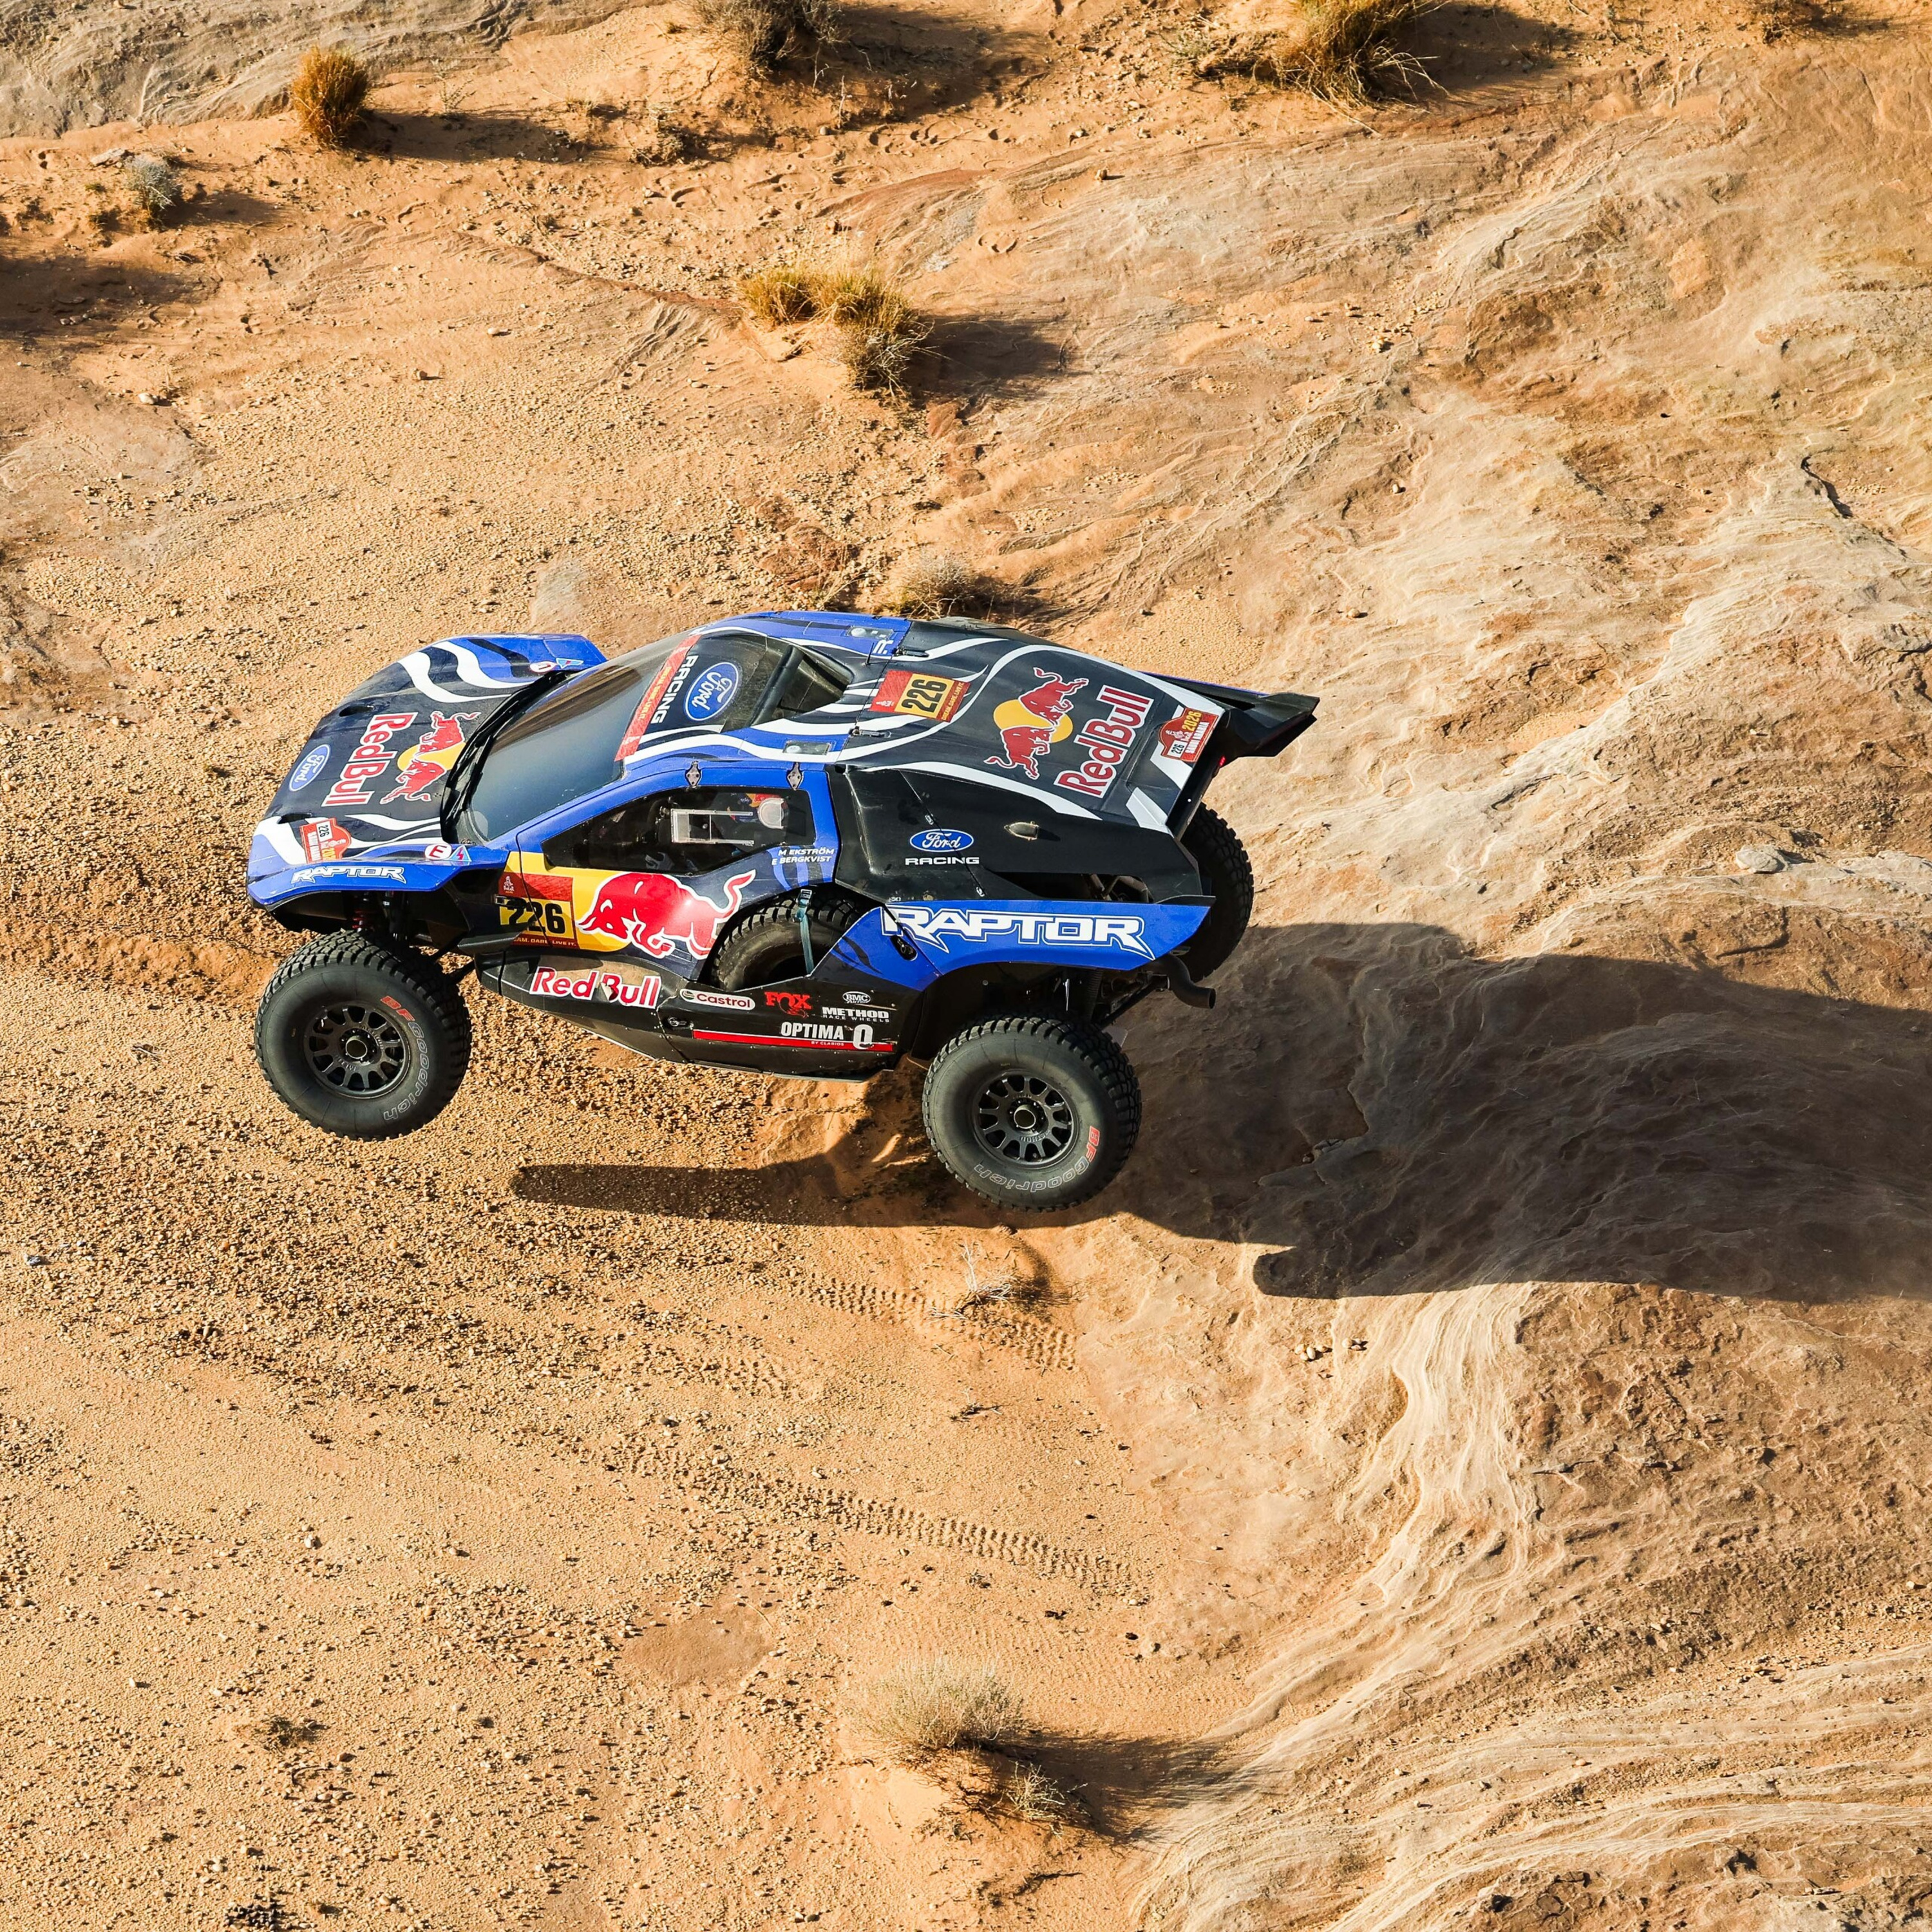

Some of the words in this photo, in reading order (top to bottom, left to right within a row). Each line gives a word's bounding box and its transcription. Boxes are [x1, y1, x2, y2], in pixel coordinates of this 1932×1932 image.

[650, 655, 699, 724] RACING
[689, 668, 734, 714] Ford
[901, 678, 947, 712] 226
[1182, 711, 1202, 732] 2026
[1171, 744, 1185, 754] 226
[293, 752, 327, 785] Ford
[318, 824, 330, 838] 226
[919, 831, 965, 849] Ford
[430, 845, 447, 858] E
[789, 847, 835, 855] EKSTRÖM
[905, 857, 980, 866] RACING
[291, 866, 406, 884] RAPTOR
[881, 905, 1155, 960] RAPTOR
[529, 966, 600, 1000] Red
[696, 993, 751, 1009] Castrol
[764, 991, 812, 1012] FOX
[822, 1007, 889, 1019] METHOD
[781, 1021, 844, 1040] OPTIMA
[974, 1126, 1101, 1193] BFGoodrich
